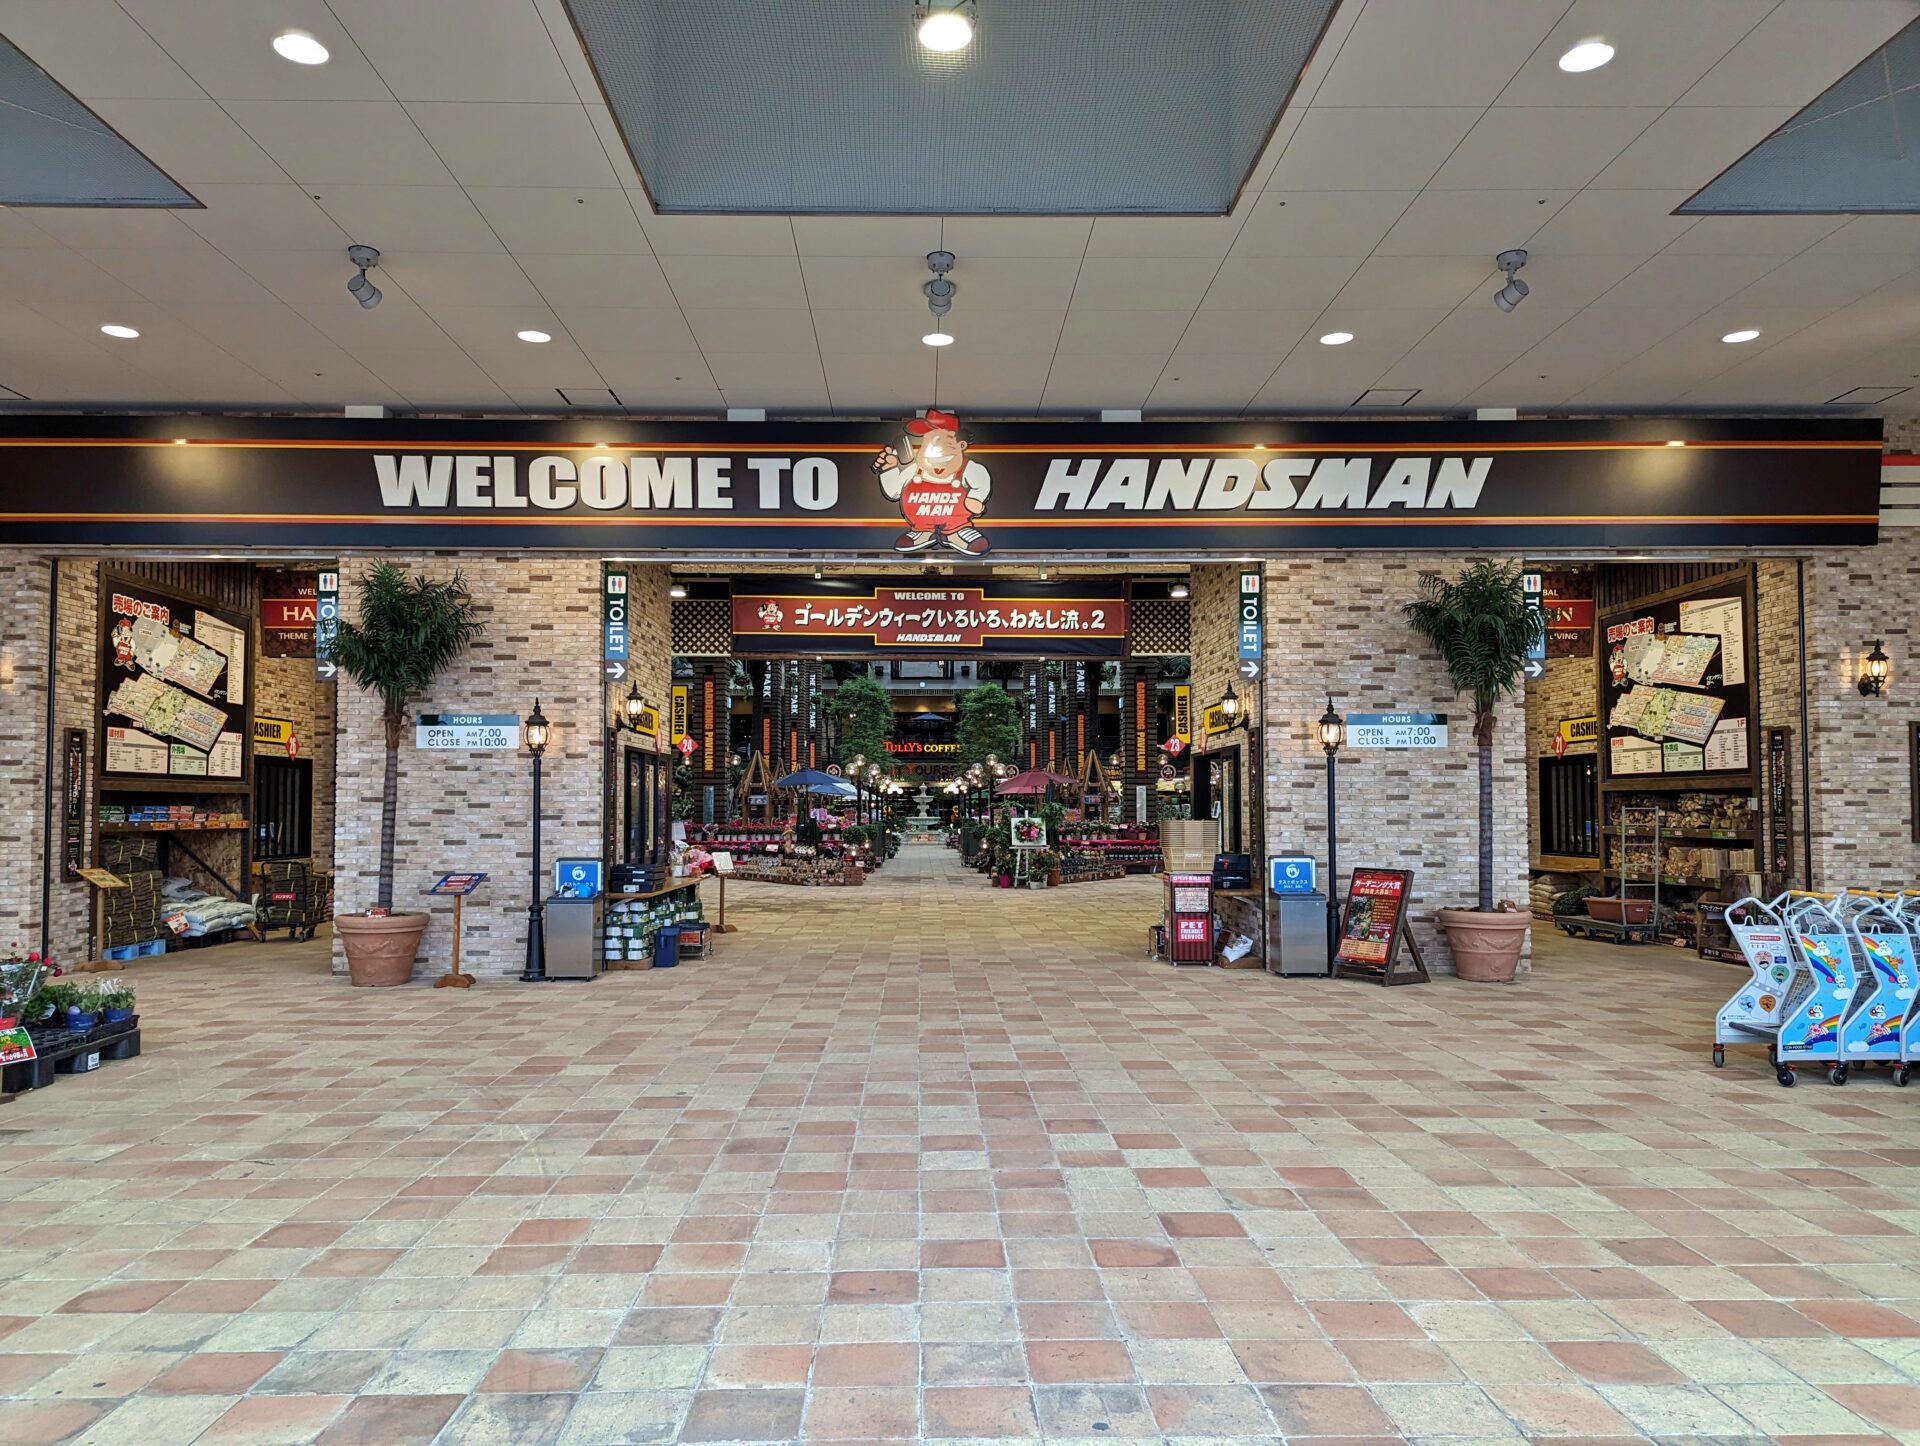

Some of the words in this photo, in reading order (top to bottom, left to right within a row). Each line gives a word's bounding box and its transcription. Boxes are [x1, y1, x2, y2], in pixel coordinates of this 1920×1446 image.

[373, 454, 735, 511] WELCOME
[748, 457, 840, 511] TO
[1034, 456, 1495, 512] HANDSMAN
[908, 492, 961, 503] HANDS
[916, 505, 954, 516] MAN
[298, 588, 317, 596] WEL
[894, 592, 947, 600] WELCOME
[951, 592, 964, 600] TO
[112, 593, 170, 625] 売場のご案内
[609, 598, 624, 654] TOILET
[1243, 597, 1257, 652] TOILET
[1607, 616, 1655, 643] 売場のご案内
[278, 632, 308, 640] THEME
[896, 633, 962, 643] HANDSMAN
[1549, 632, 1578, 640] LVING
[762, 673, 772, 697] PARK
[1076, 669, 1085, 693] PARK
[1048, 694, 1056, 714] PARK
[453, 716, 482, 724] HOURS
[674, 695, 685, 735] CASHIER
[1178, 695, 1188, 735] CASHIER
[254, 720, 281, 739] ASHIER
[428, 729, 454, 738] OPEN
[1358, 728, 1383, 736] OPEN
[1570, 720, 1597, 737] CASHIE
[427, 738, 460, 746] CLOSE
[682, 741, 693, 753] 24
[1170, 739, 1180, 752] 23
[1358, 737, 1390, 745] CLOSE
[704, 731, 714, 771] PAVILION
[1136, 731, 1145, 771] PAVILION
[1180, 921, 1204, 929] PET
